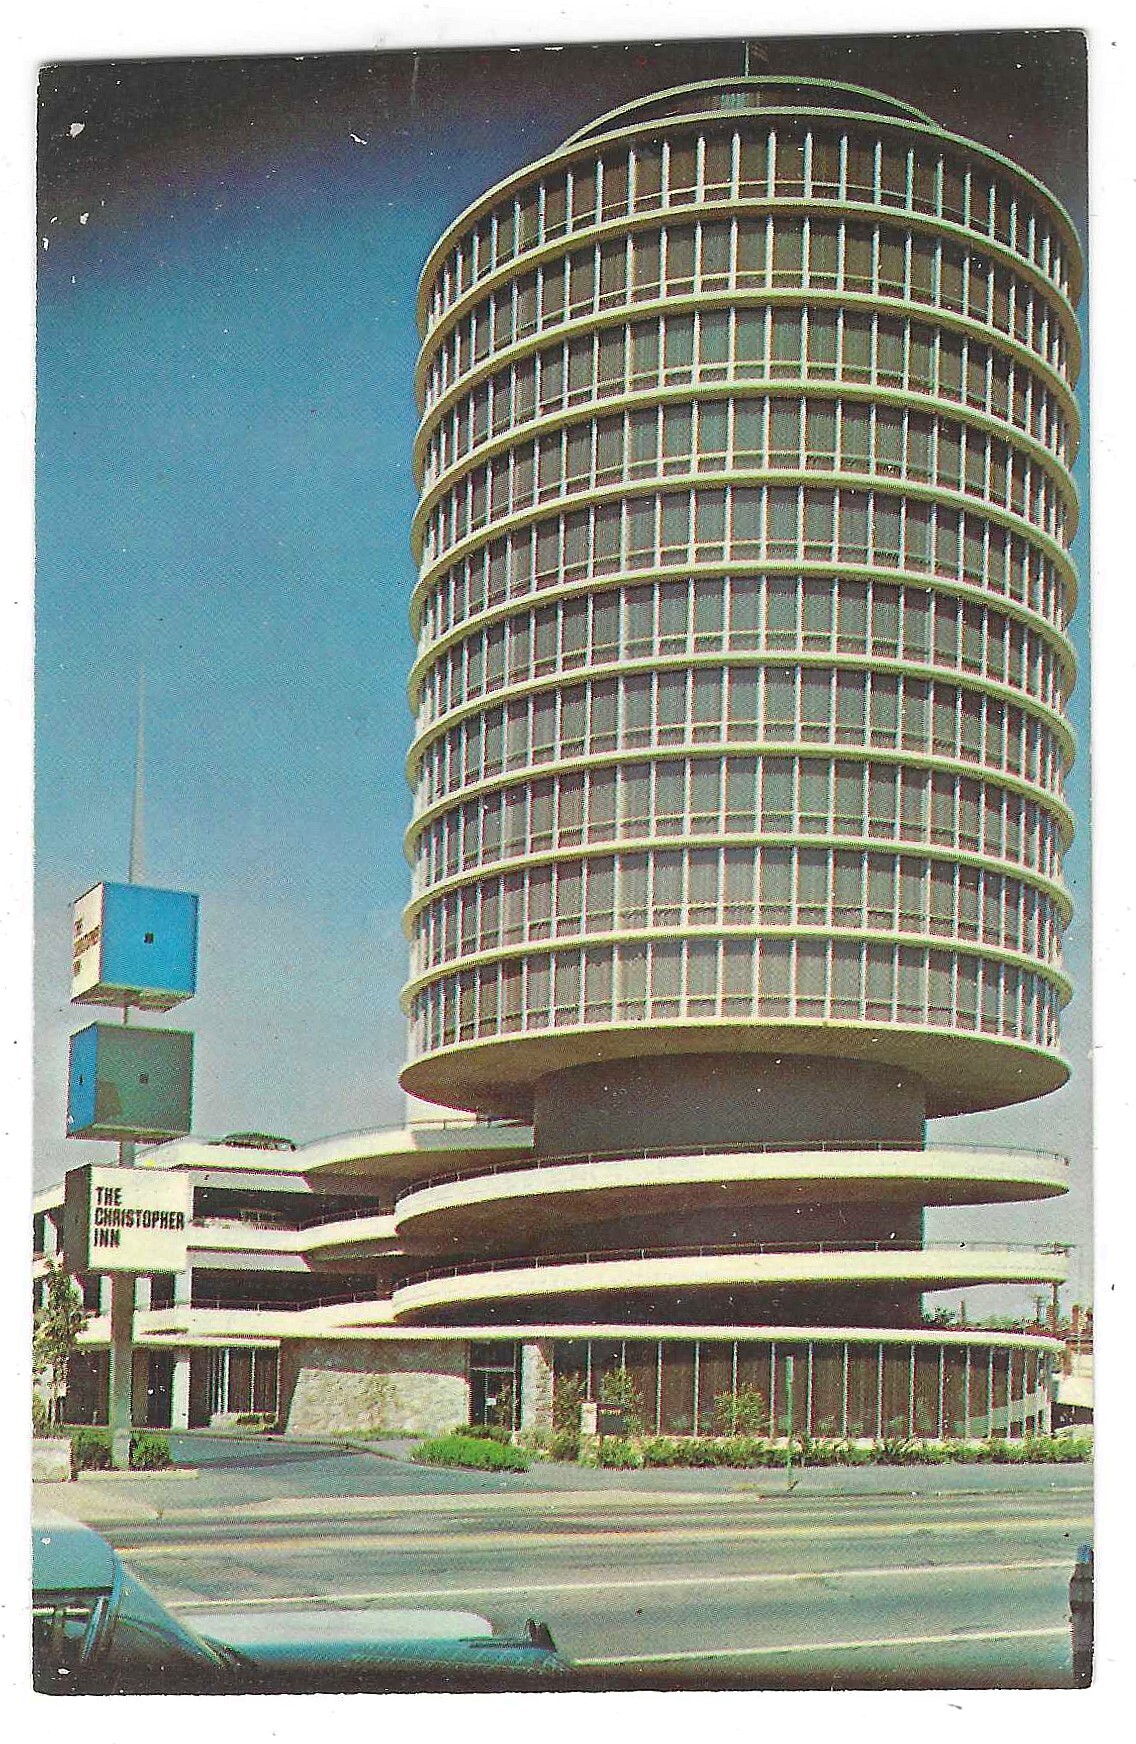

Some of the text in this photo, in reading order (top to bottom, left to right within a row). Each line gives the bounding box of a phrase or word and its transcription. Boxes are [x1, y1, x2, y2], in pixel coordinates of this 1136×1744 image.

[95, 1186, 122, 1206] THE
[94, 1207, 185, 1230] CHRISTOPHER
[93, 1228, 121, 1248] INN
